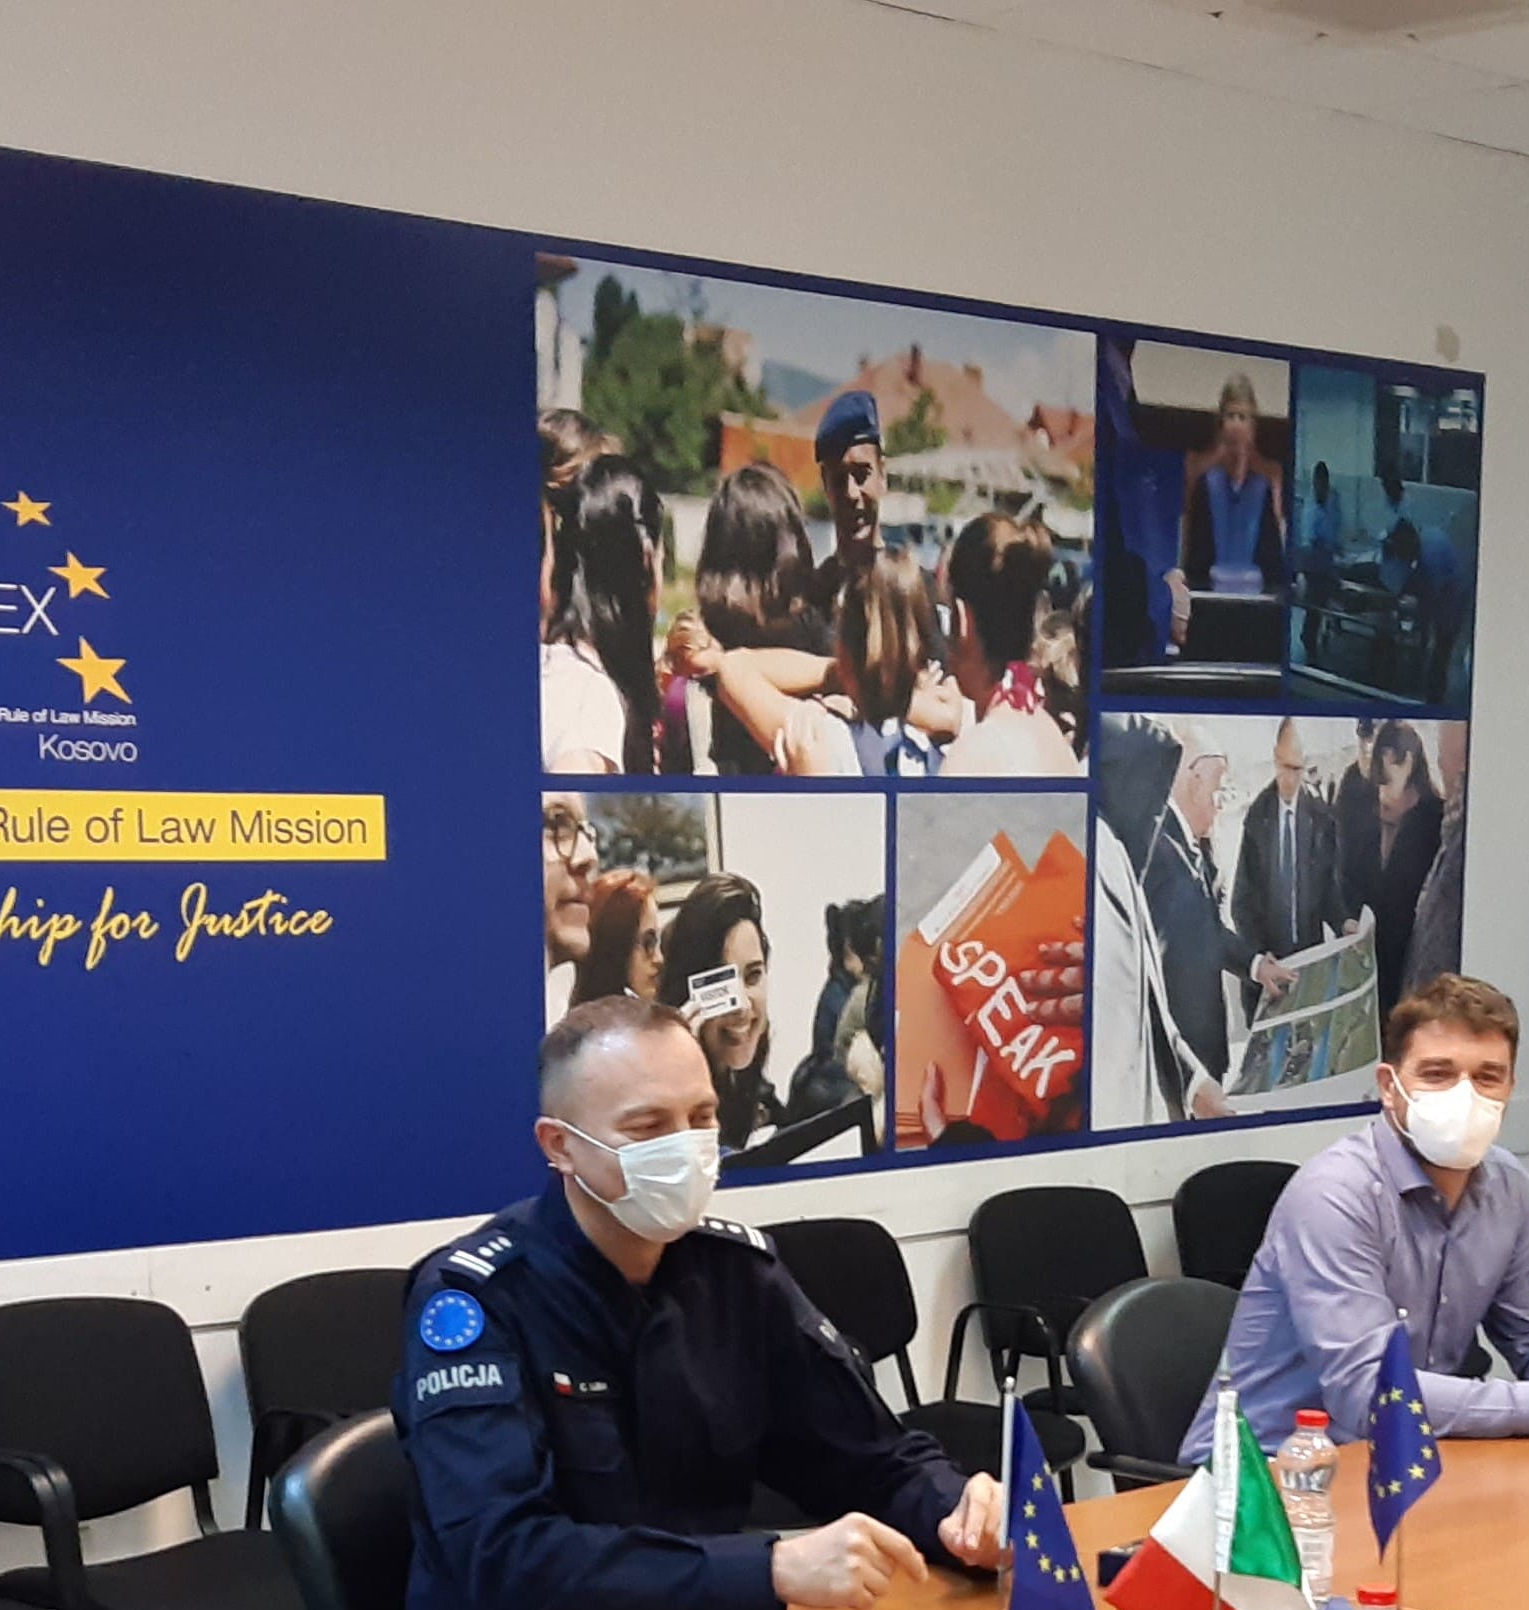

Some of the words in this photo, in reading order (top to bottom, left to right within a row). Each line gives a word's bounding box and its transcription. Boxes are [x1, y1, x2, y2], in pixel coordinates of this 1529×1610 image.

[32, 709, 47, 723] of
[50, 710, 80, 724] Law
[83, 711, 137, 726] Mission
[39, 734, 138, 762] Kosovo
[85, 808, 124, 844] of
[137, 809, 216, 844] Law
[230, 809, 367, 845] Mission
[90, 887, 159, 971] for
[175, 882, 333, 963] Justice
[939, 940, 1076, 1098] SPEAK
[416, 1364, 504, 1401] POLICJA
